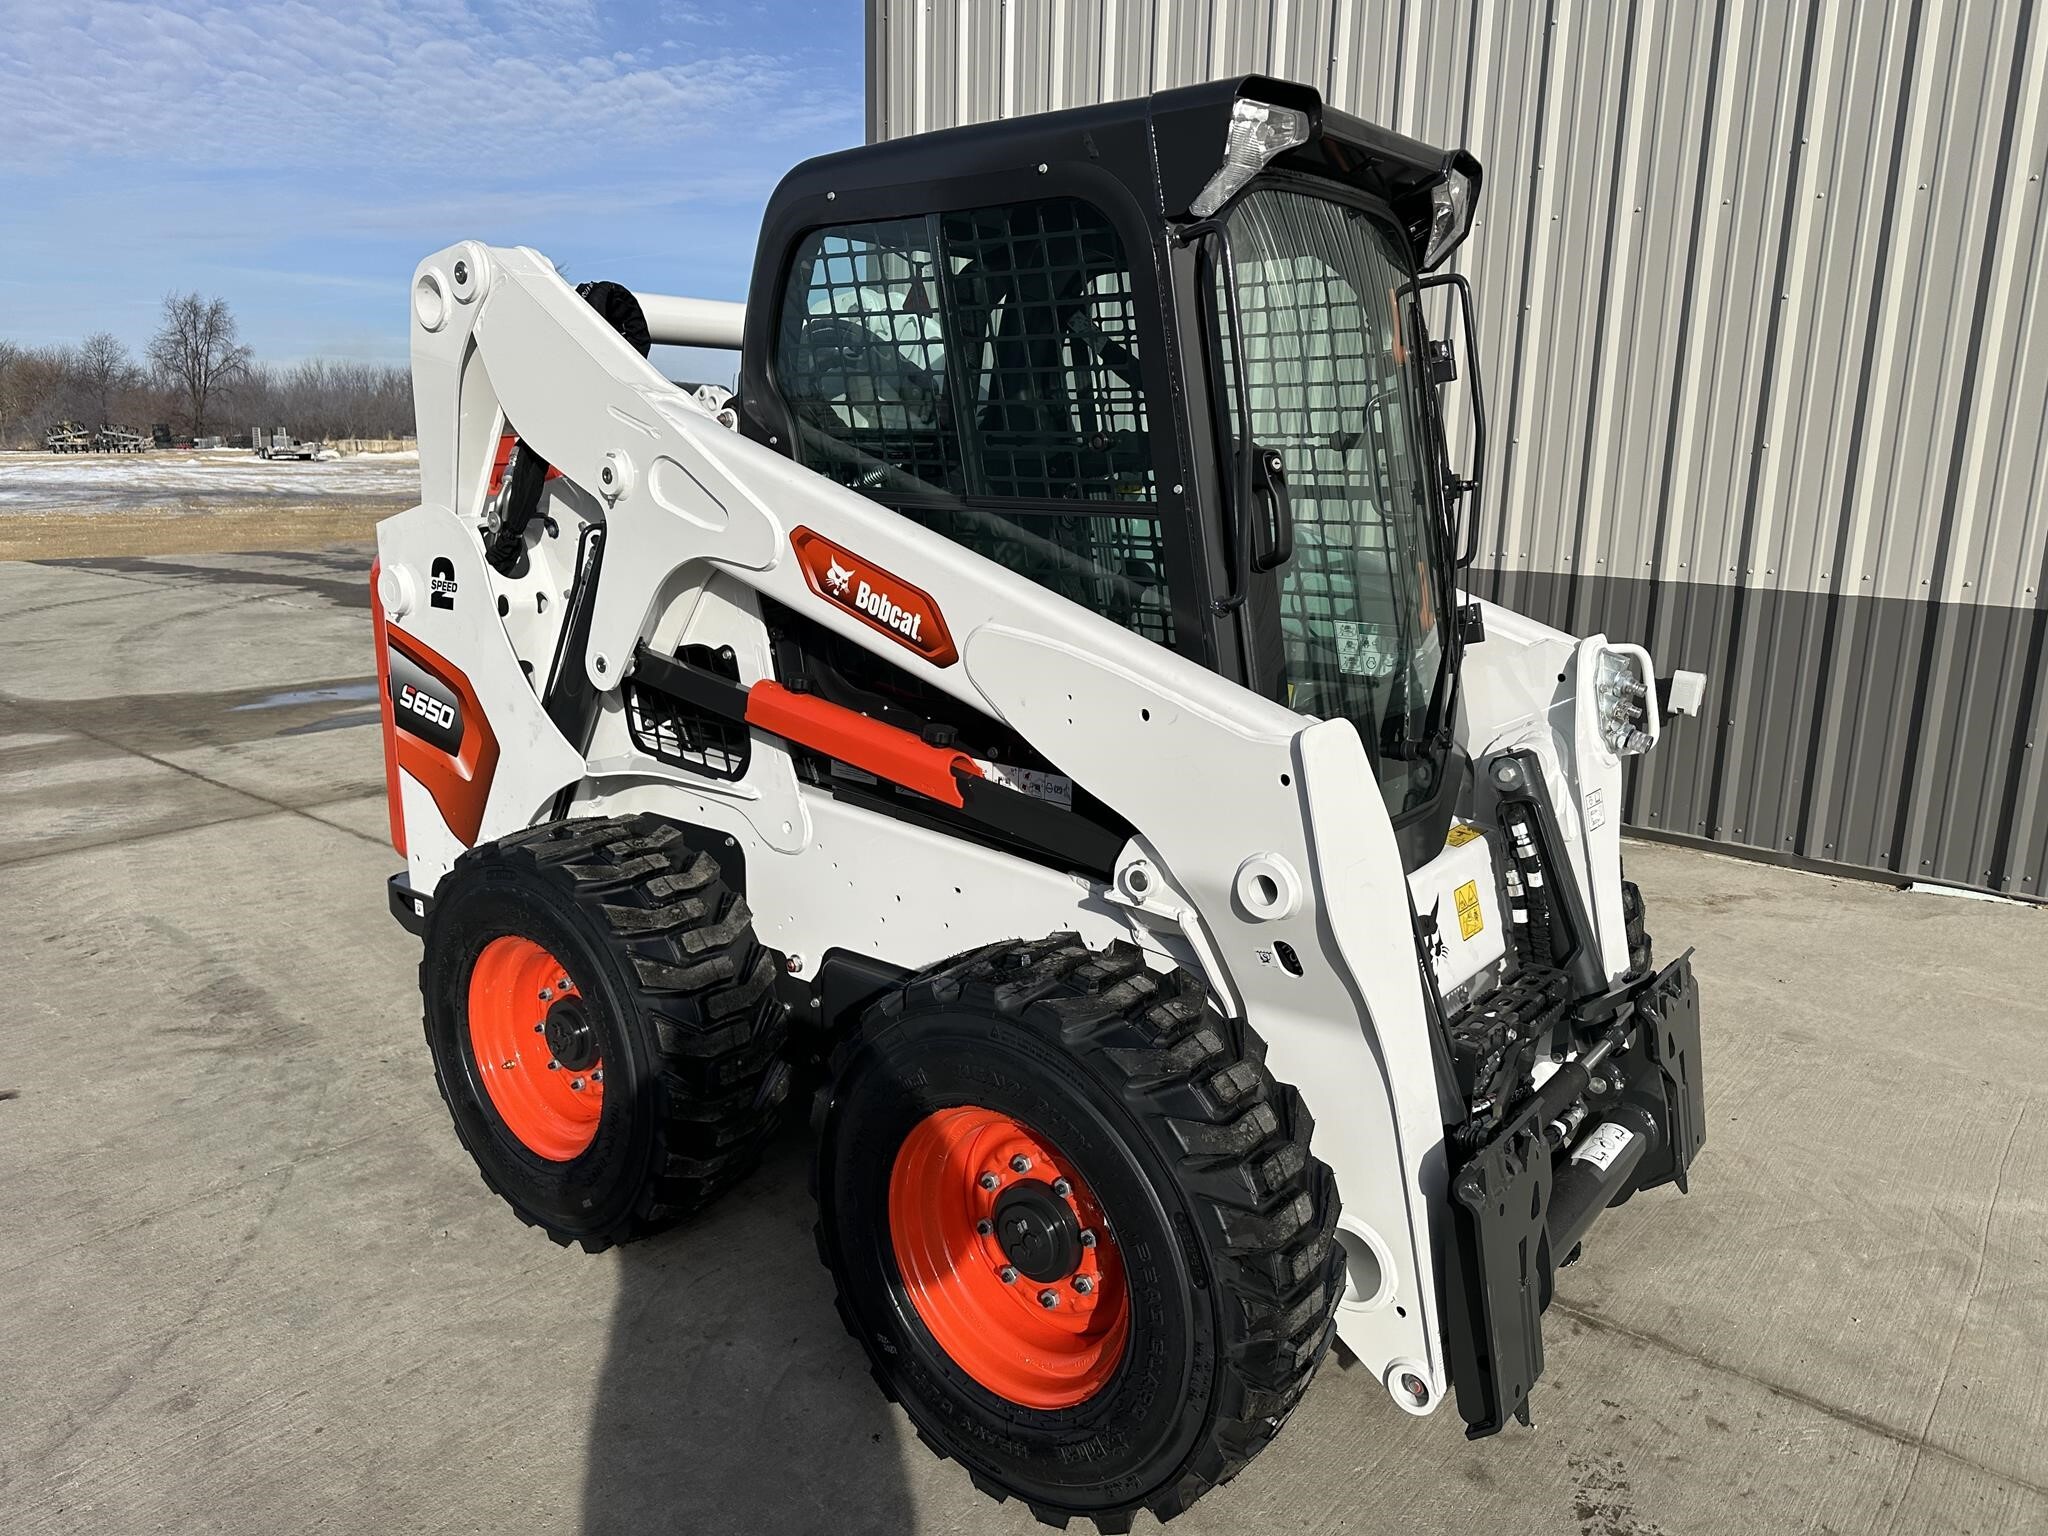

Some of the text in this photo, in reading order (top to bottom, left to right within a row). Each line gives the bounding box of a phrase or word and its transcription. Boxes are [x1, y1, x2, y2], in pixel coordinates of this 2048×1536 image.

[430, 579, 458, 593] SPEED
[855, 580, 922, 641] Bobcat
[399, 684, 455, 730] S650
